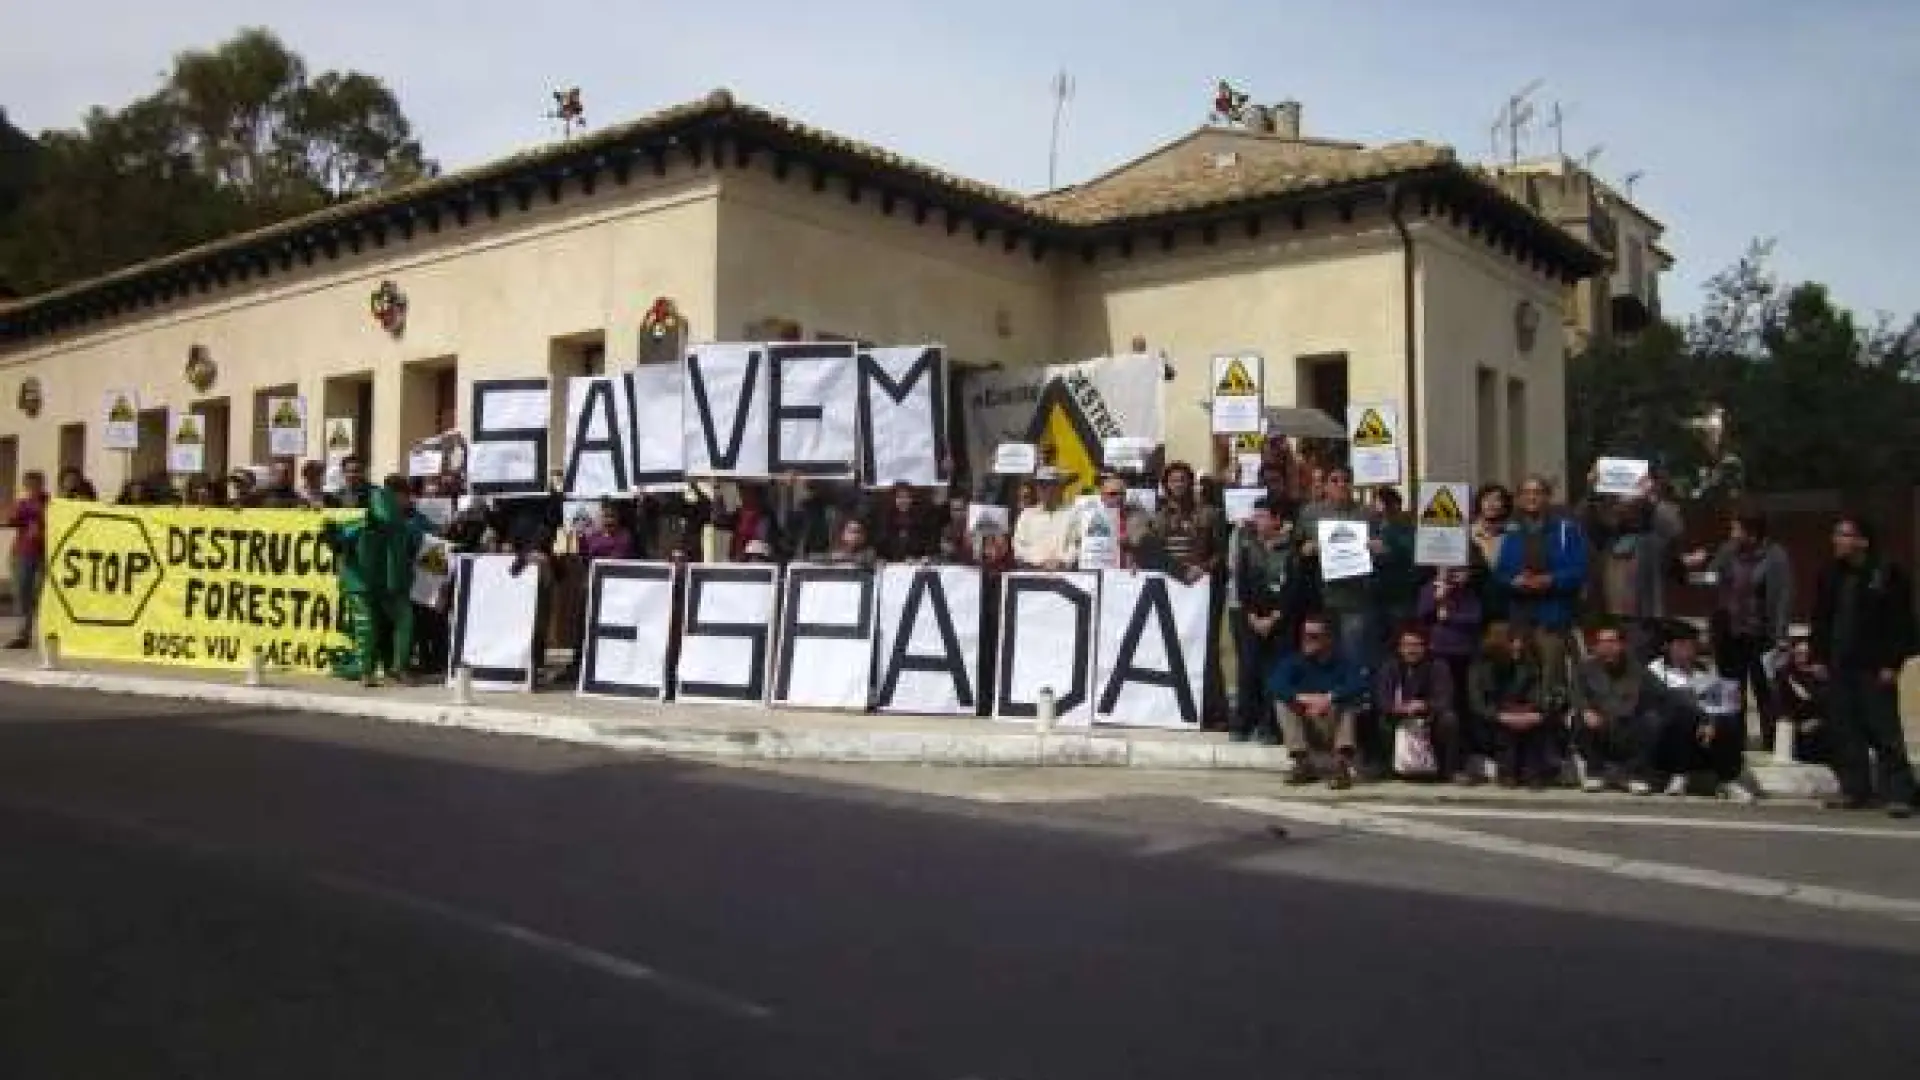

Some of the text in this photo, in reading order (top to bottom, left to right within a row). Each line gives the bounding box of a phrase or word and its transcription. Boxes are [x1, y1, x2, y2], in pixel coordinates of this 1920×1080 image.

[472, 345, 949, 494] SALVEM
[62, 549, 151, 594] STOP
[143, 632, 196, 659] BOSC
[205, 636, 241, 662] VIU
